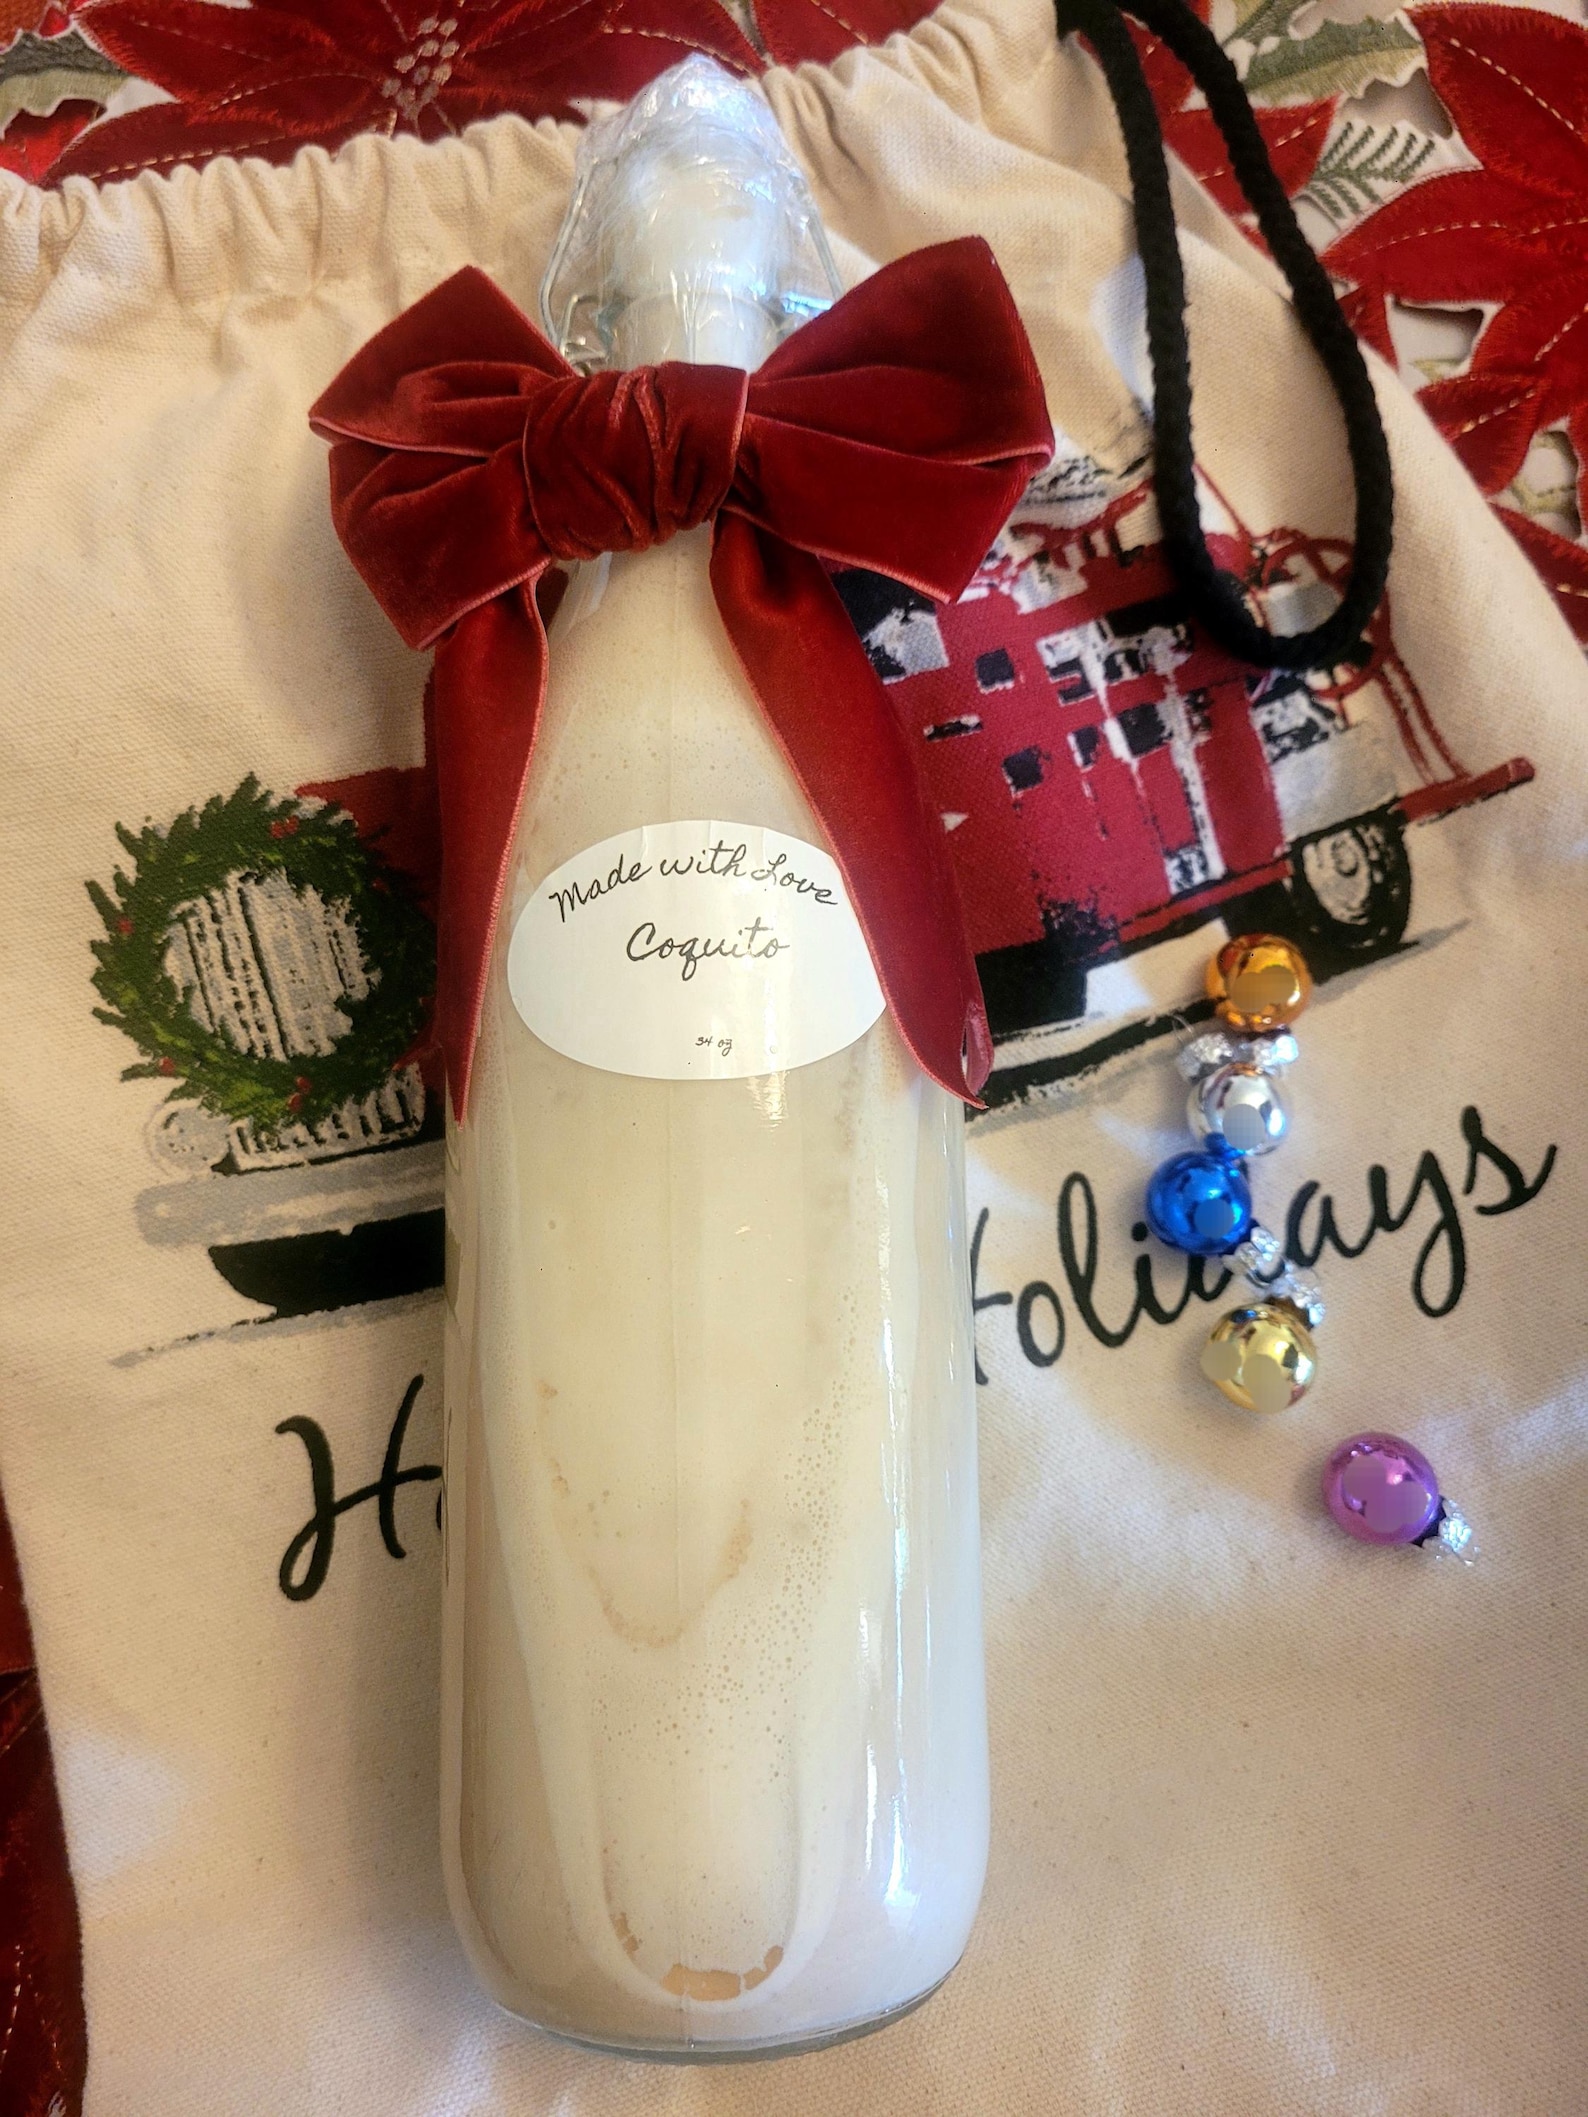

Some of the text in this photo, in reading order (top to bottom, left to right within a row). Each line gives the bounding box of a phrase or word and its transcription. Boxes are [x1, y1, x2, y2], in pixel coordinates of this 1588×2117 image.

[548, 839, 839, 923] Made with Love
[626, 916, 791, 981] Coquito
[694, 1035, 733, 1057] 34 oz
